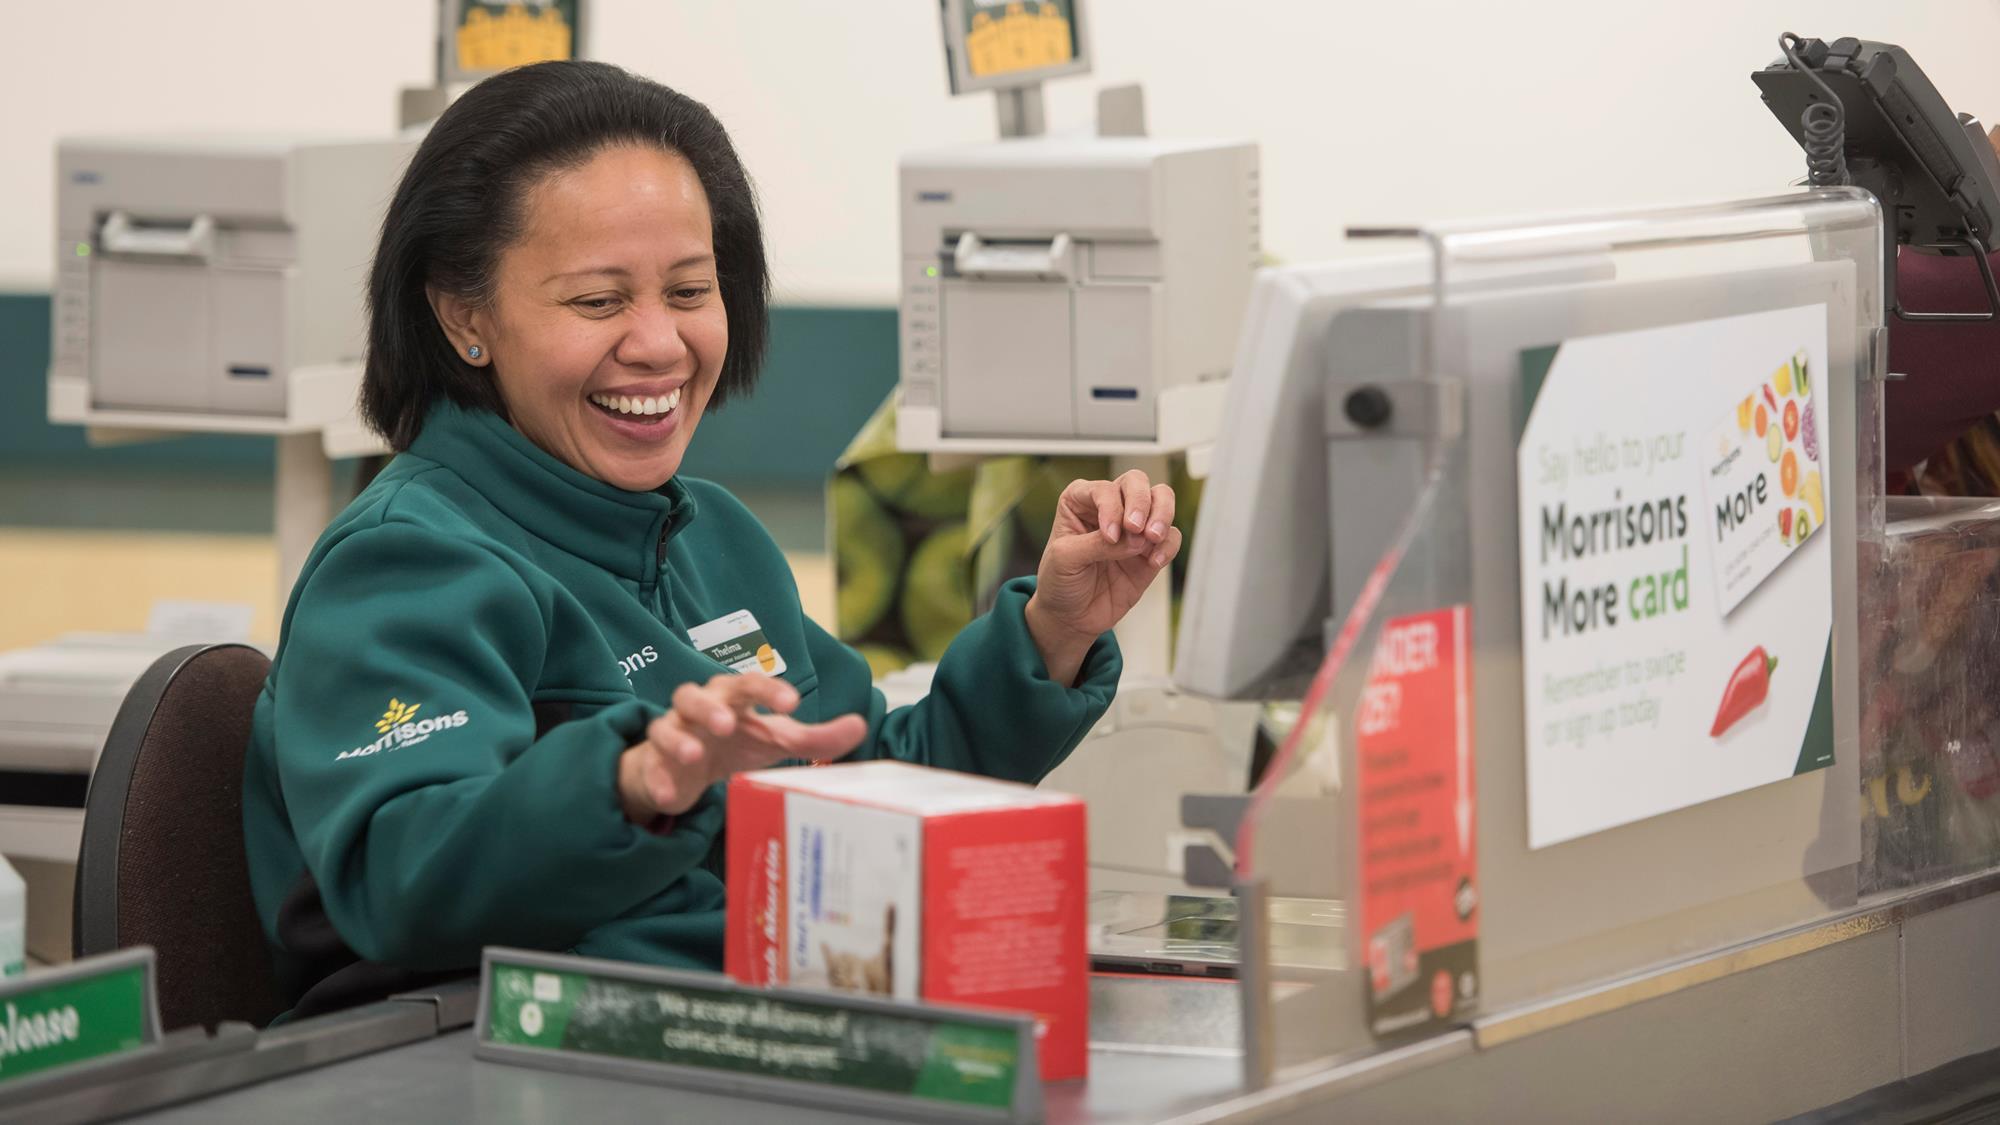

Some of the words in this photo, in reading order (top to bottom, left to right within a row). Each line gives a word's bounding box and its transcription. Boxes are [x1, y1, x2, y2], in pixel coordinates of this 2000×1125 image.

[1574, 433, 1617, 475] hello
[1621, 436, 1643, 469] to
[1647, 431, 1686, 476] your
[1540, 487, 1688, 565] Morrisons
[1716, 472, 1769, 543] More
[1542, 576, 1619, 640] More
[1628, 544, 1689, 621] card
[711, 643, 743, 659] Thelma
